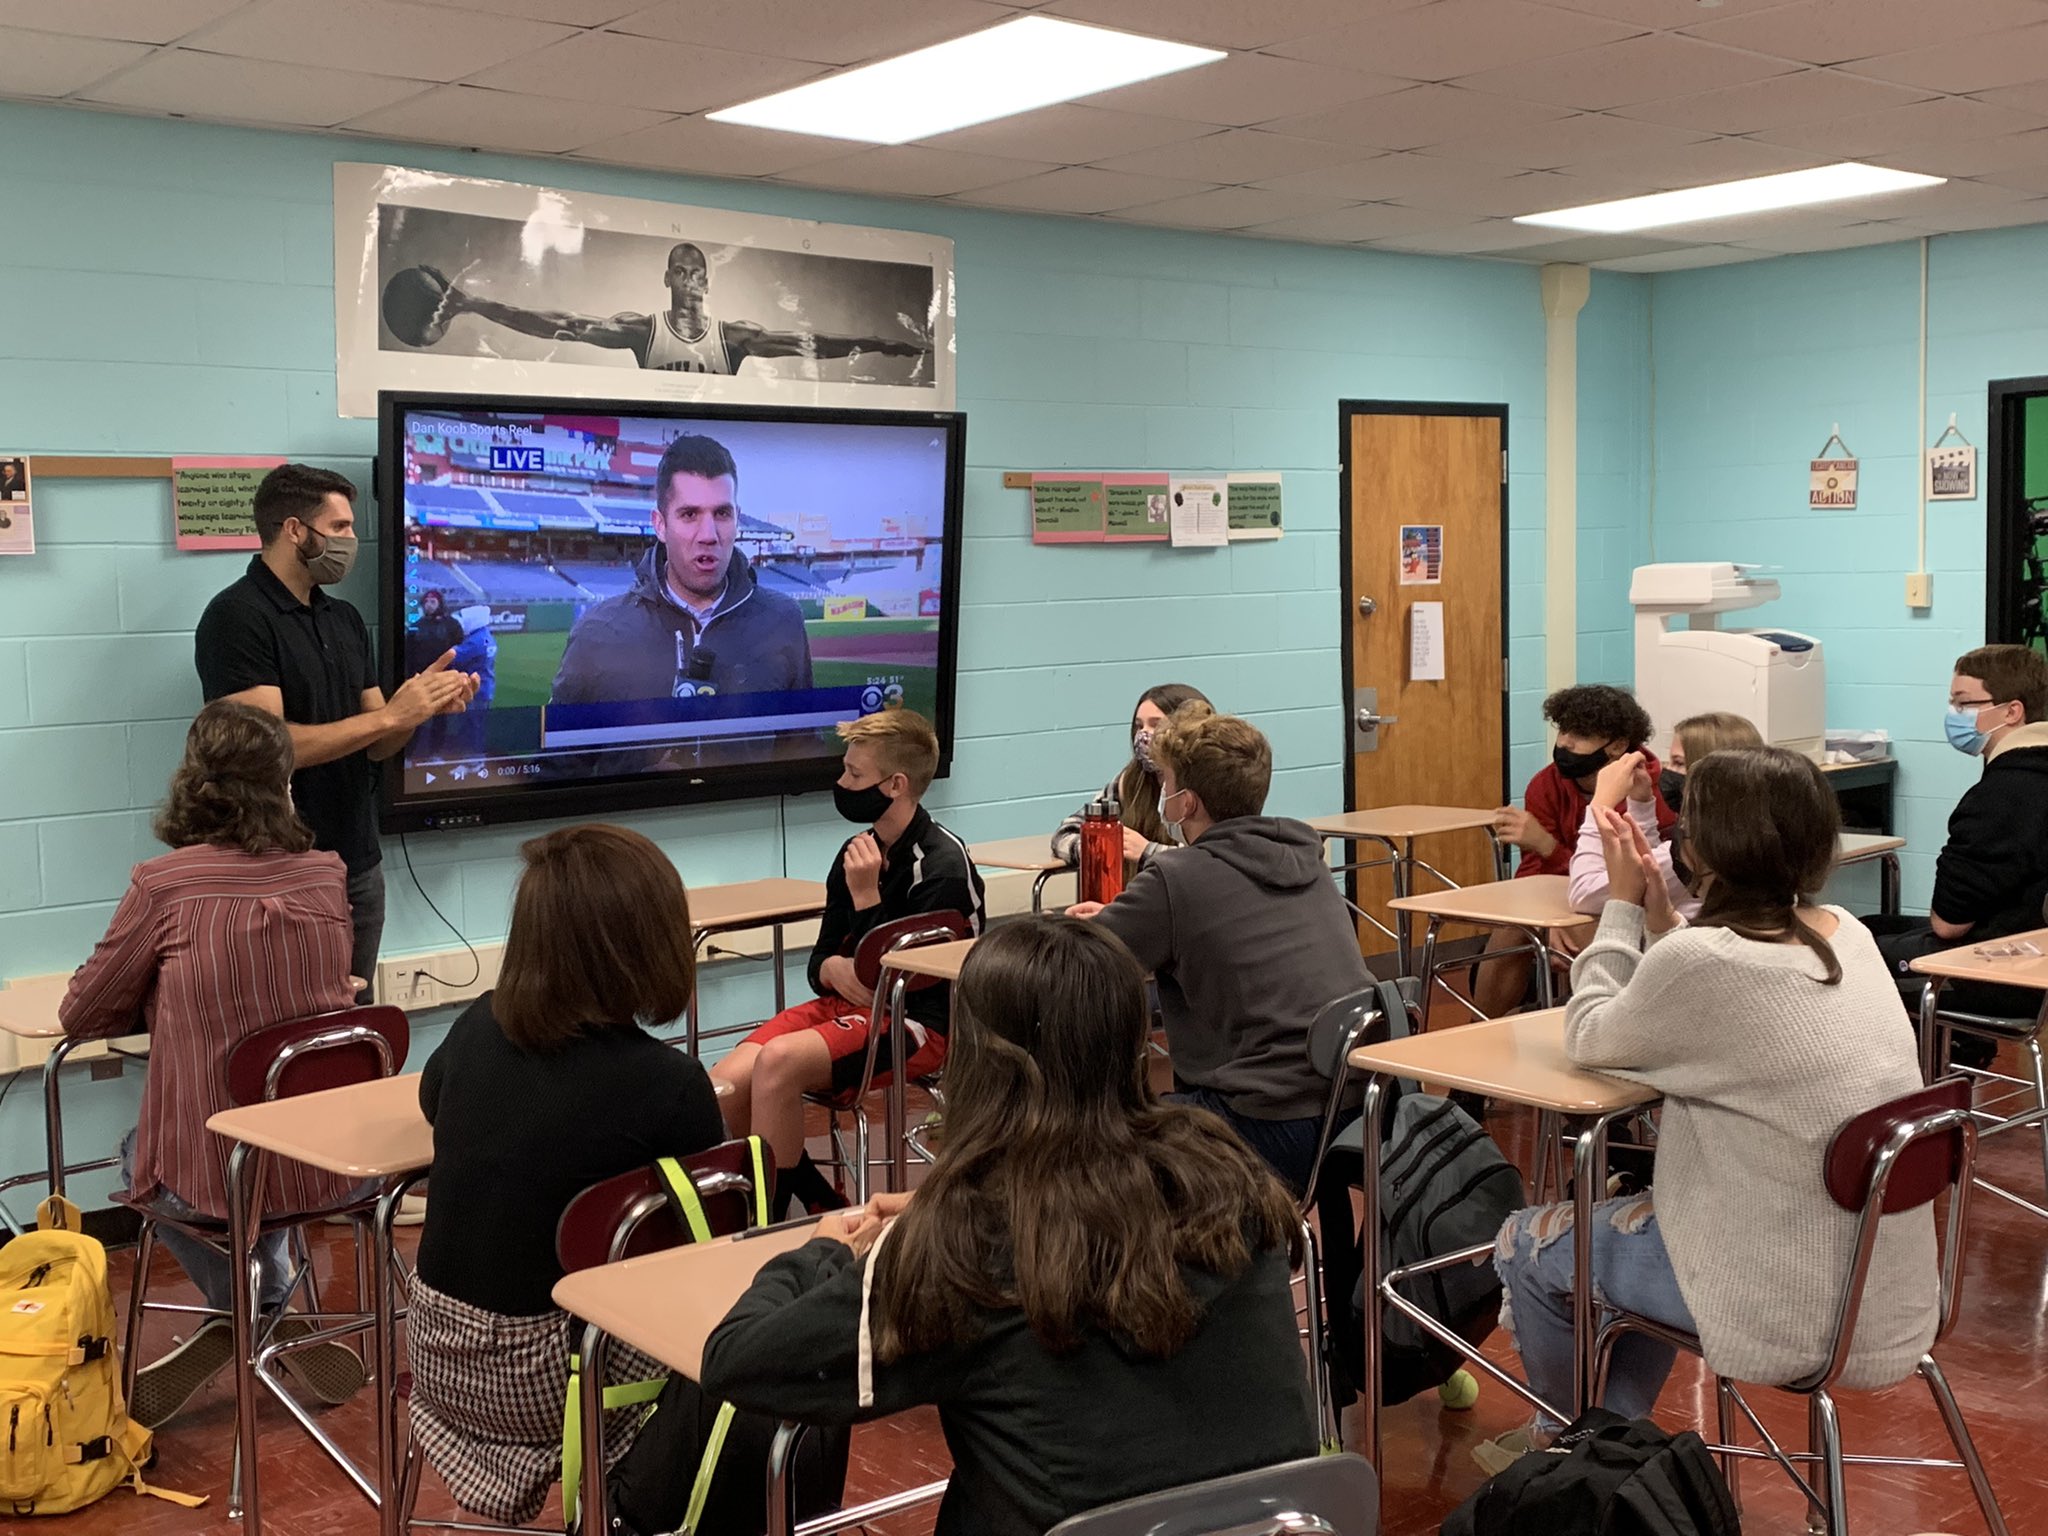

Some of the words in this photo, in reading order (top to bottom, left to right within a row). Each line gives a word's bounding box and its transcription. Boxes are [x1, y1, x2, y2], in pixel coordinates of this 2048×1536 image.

[671, 223, 681, 233] N
[412, 421, 435, 434] Dan
[437, 422, 467, 435] Koob
[470, 423, 507, 438] Sports
[509, 424, 532, 436] Reel
[493, 449, 542, 469] LIVE
[229, 471, 252, 480] stops
[177, 486, 211, 494] learning
[1934, 479, 1969, 493] SHOWING
[1811, 490, 1853, 504] ACTION
[178, 499, 206, 508] twenty
[196, 513, 220, 522] keeps
[218, 526, 243, 536] Henry
[497, 767, 516, 776] 0:00
[523, 764, 541, 774] 5:16
